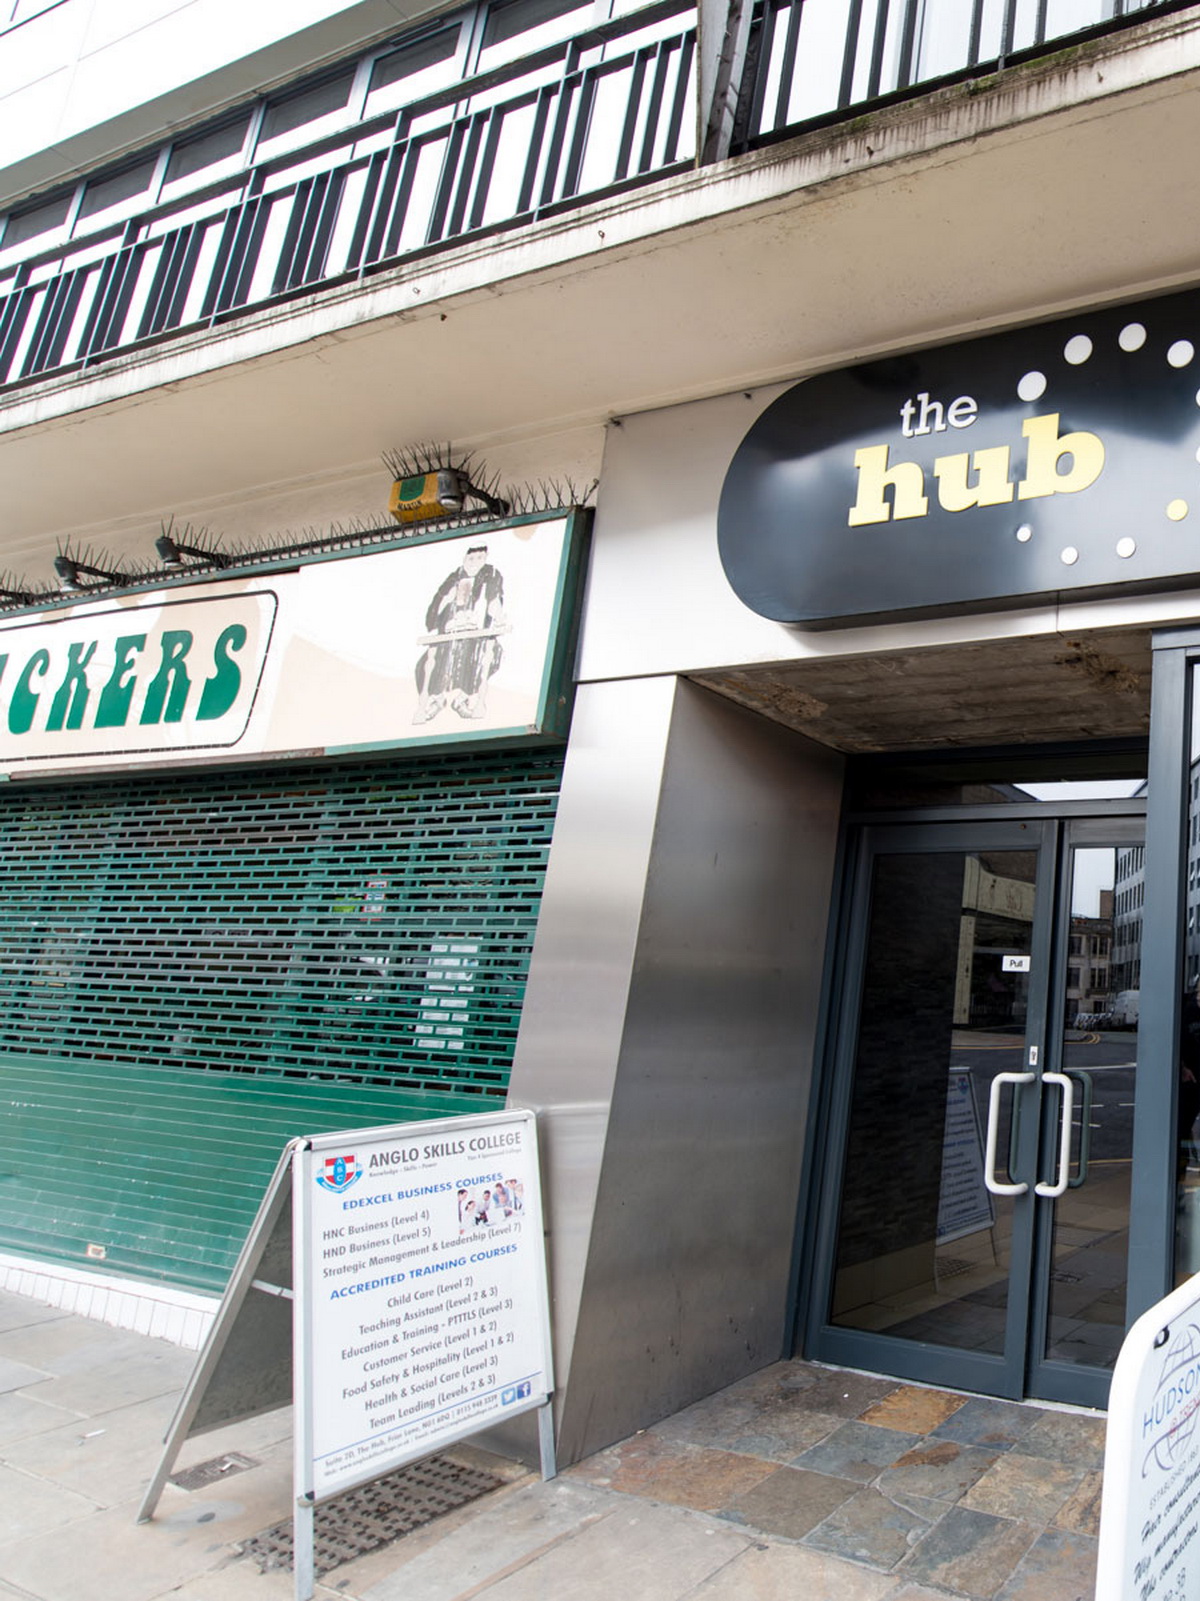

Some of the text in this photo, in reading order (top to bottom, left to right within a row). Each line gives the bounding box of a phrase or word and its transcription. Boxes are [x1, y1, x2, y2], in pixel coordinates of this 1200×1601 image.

[900, 392, 978, 438] the
[847, 412, 1105, 527] hub
[368, 1131, 521, 1169] ANGLO SKILLS COLLEGE
[342, 1172, 504, 1211] EDEXCEL BUSINESS COURSES
[323, 1209, 430, 1241] HNC Business (Level 4)
[323, 1226, 432, 1260] HND Business (Level 5)
[323, 1222, 522, 1279] Strategic Management & Leadership (Level 7)
[330, 1243, 518, 1300] ACCREDITED TRAINING COURSES
[387, 1275, 474, 1308] Child Care (Level 2)
[341, 1339, 390, 1361] Education
[392, 1334, 400, 1344] &
[402, 1322, 439, 1341] Training
[478, 1302, 503, 1319] (Level
[504, 1298, 513, 1309] 3)
[359, 1285, 498, 1336] Teaching Assistant (Level 2 & 3)
[342, 1381, 368, 1399] Food
[370, 1370, 400, 1389] Safety
[402, 1368, 410, 1378] &
[412, 1352, 461, 1375] Hospitality
[463, 1341, 488, 1360] (Level
[497, 1336, 504, 1346] &
[505, 1331, 515, 1343] 2)
[363, 1351, 408, 1372] Customer
[410, 1341, 442, 1357] Service
[444, 1330, 470, 1348] (Level
[479, 1324, 487, 1334] &
[488, 1320, 498, 1331] 2)
[364, 1354, 499, 1411] Health & Social Care (Level 3)
[369, 1373, 496, 1429] Team Leading (Levels 2 & 3)
